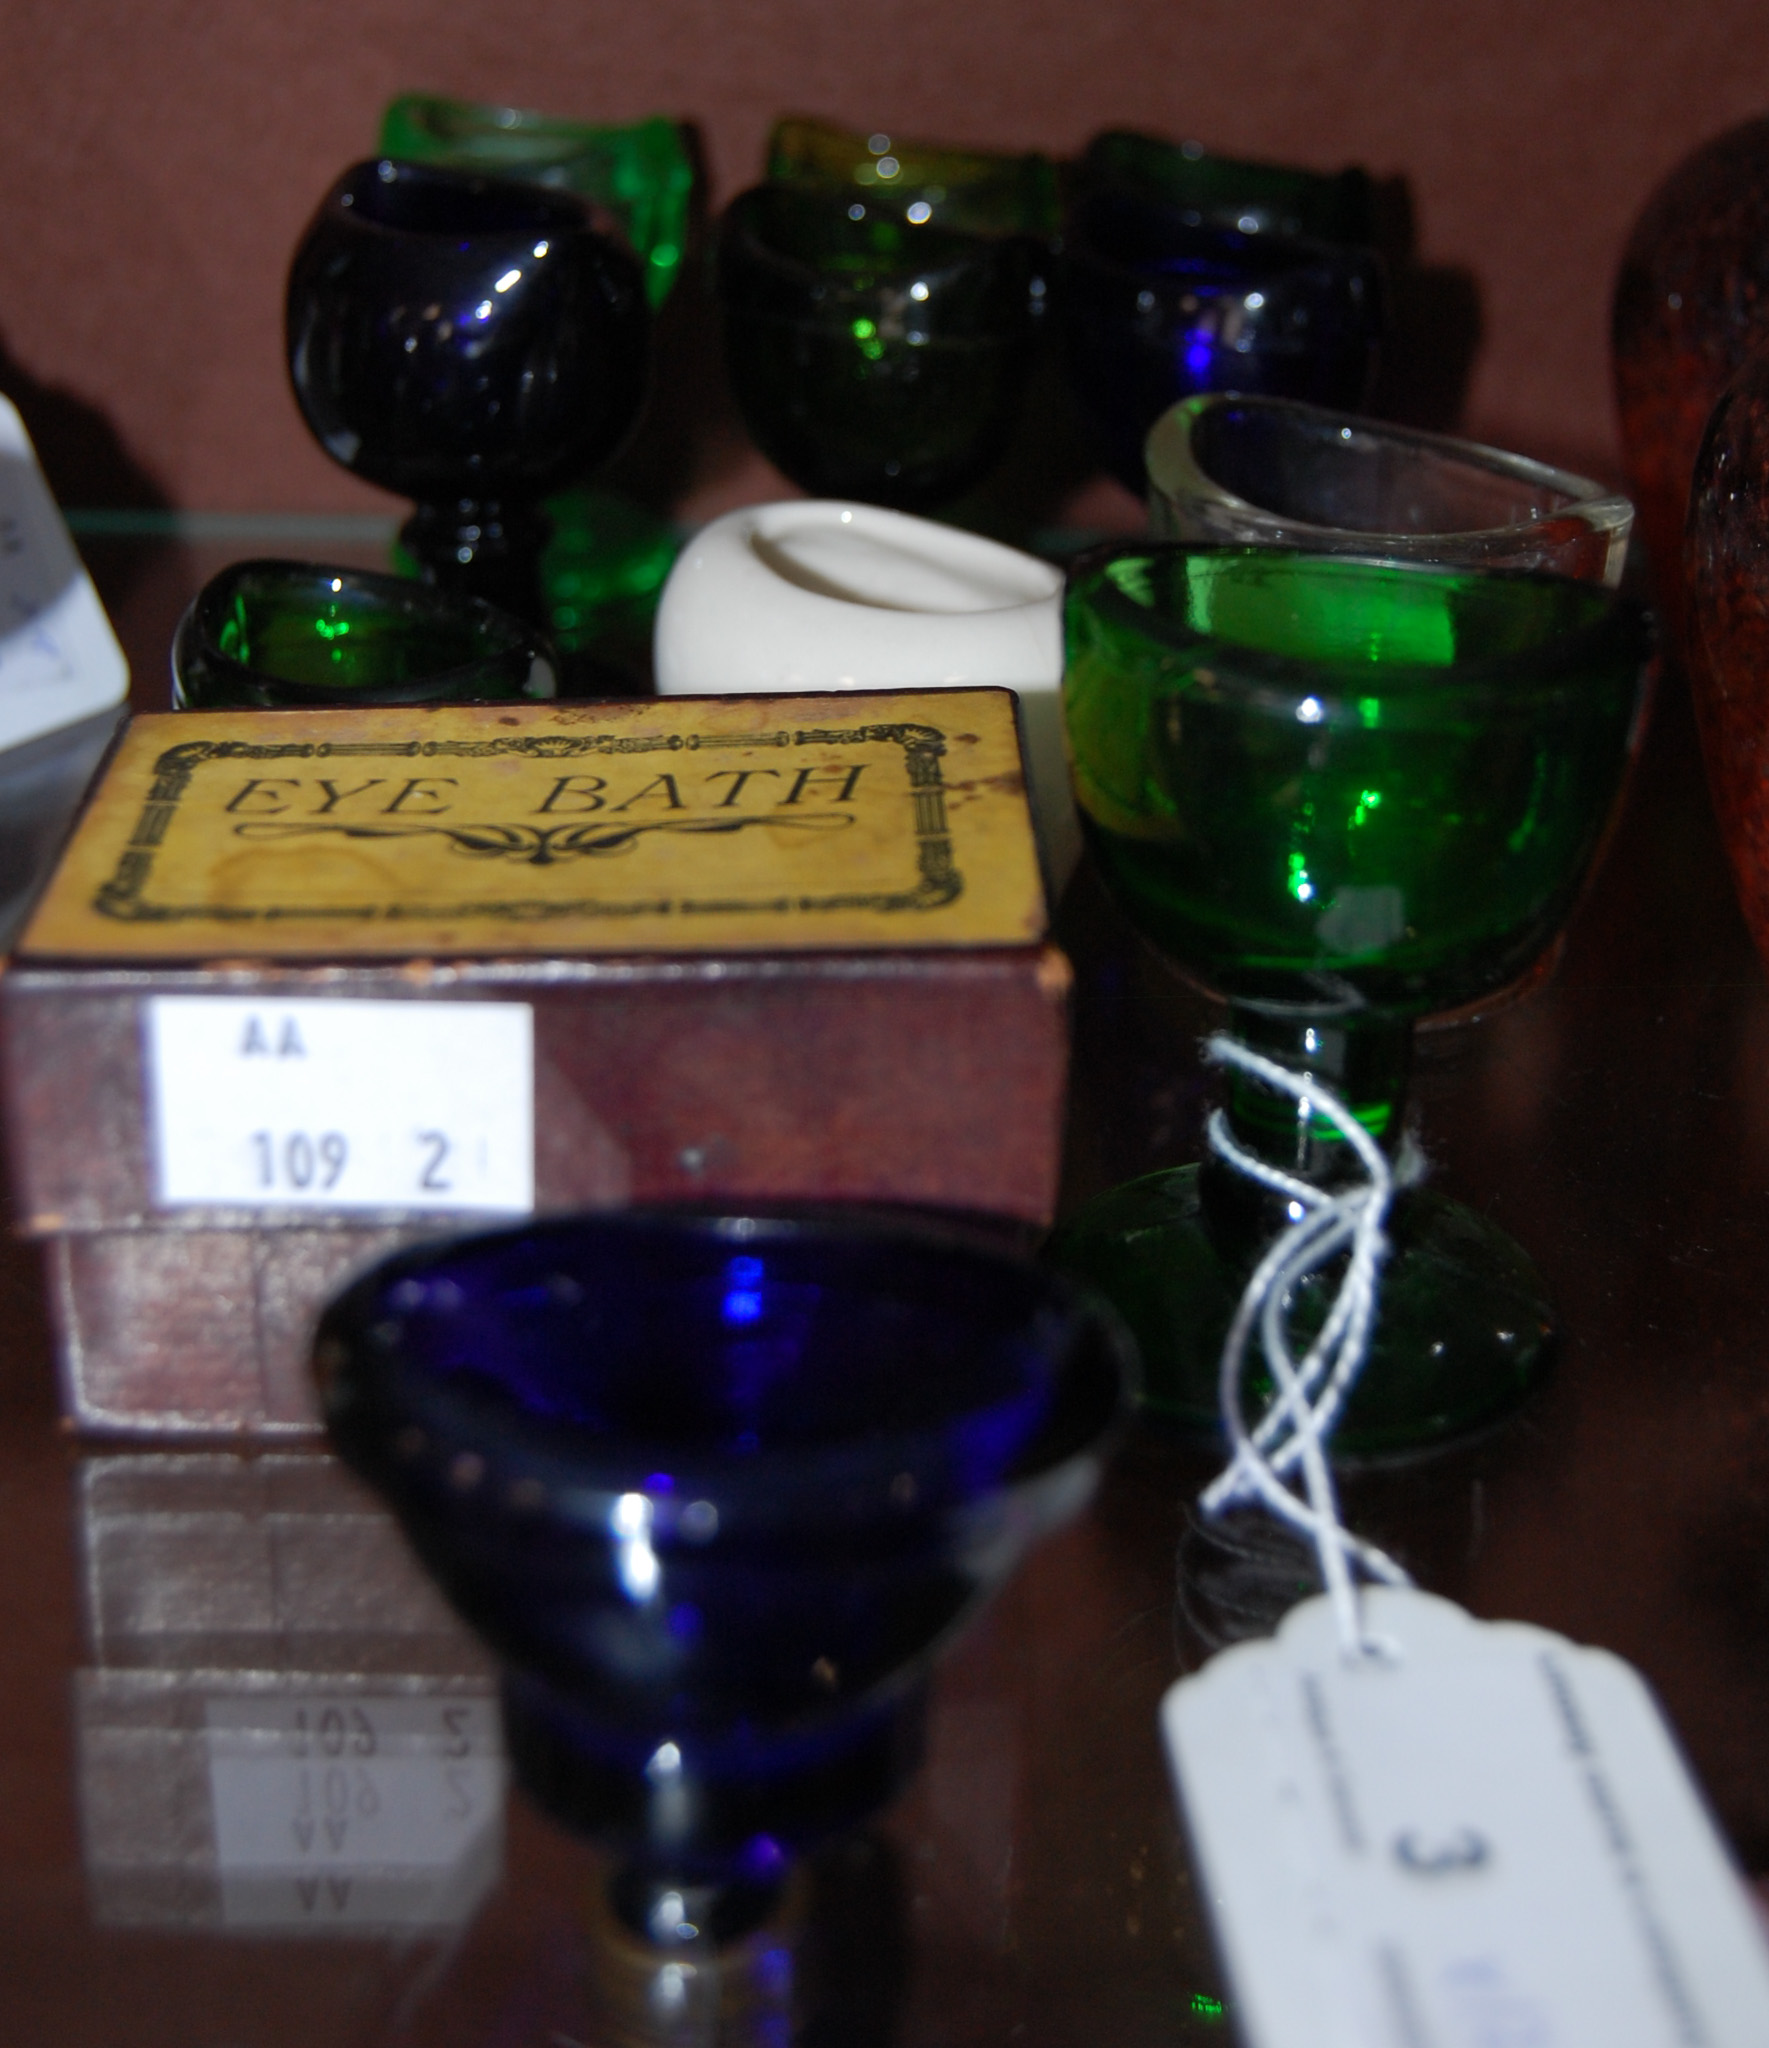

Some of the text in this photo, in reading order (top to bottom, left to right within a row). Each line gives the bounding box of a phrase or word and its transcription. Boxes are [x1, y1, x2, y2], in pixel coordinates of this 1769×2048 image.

[224, 763, 873, 815] EYE BATH
[239, 1012, 307, 1060] AA
[250, 1129, 454, 1193] 109 2
